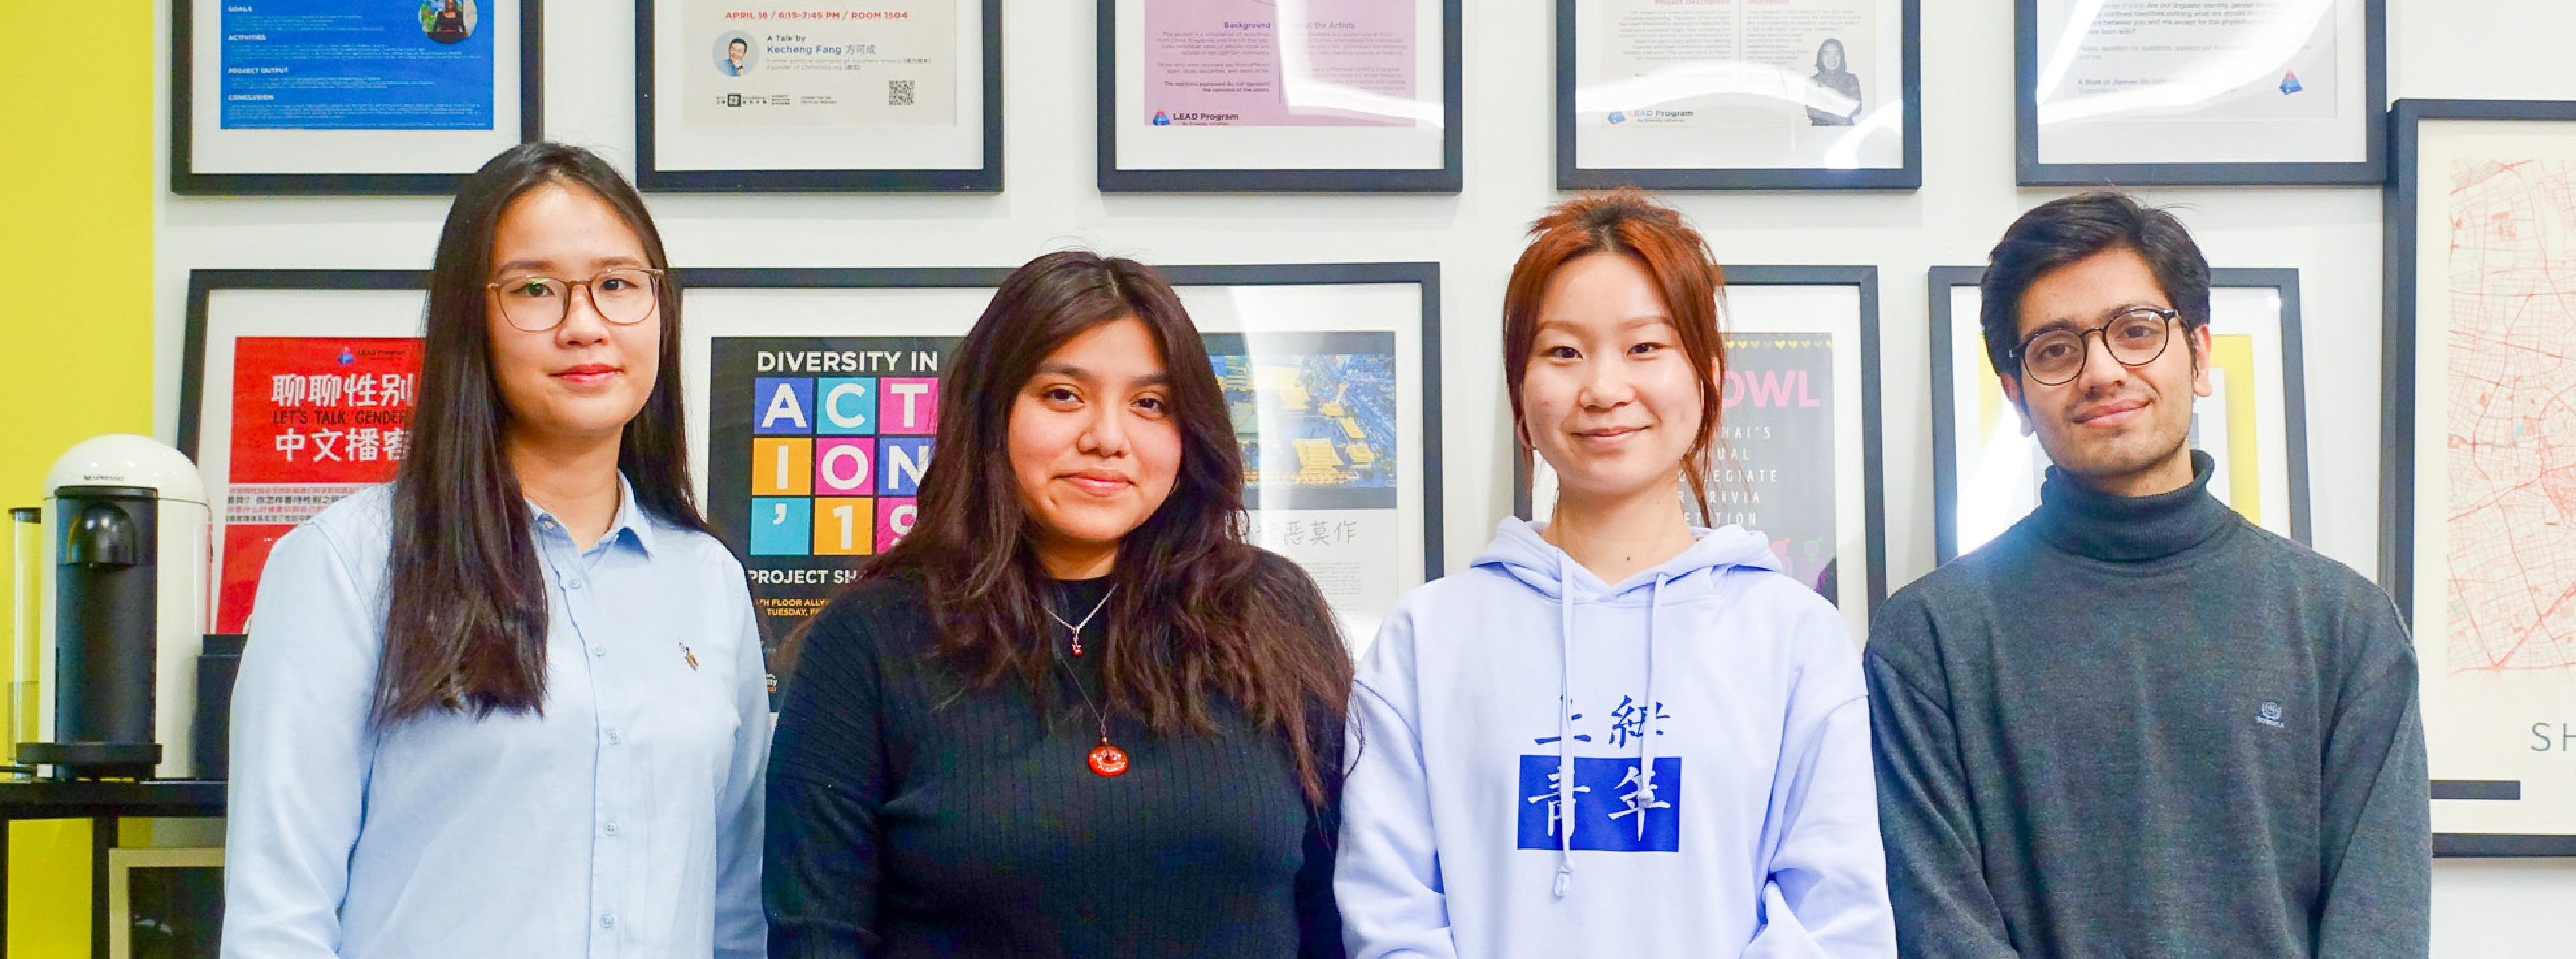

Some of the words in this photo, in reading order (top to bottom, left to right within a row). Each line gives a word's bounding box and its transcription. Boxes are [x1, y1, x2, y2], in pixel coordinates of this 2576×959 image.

[725, 11, 755, 20] APRIL
[758, 11, 767, 20] 16
[778, 11, 823, 20] 6:15-7:45
[826, 11, 840, 20] PM
[851, 11, 881, 20] ROOM
[885, 11, 908, 20] 1504
[767, 45, 813, 55] Kecheng
[816, 45, 842, 55] Fang
[1201, 112, 1239, 121] Program
[757, 351, 901, 372] DIVERSITY
[911, 351, 938, 372] IN
[271, 373, 414, 407] 聊聊性别
[273, 408, 307, 424] LET'S
[314, 410, 345, 424] TALK
[1722, 426, 1771, 439] HAI'S
[276, 428, 411, 462] 中文播客
[1717, 448, 1749, 460] UAL
[1710, 491, 1760, 504] RIVIA
[1684, 512, 1757, 526] ETTION
[1255, 520, 1358, 545] 恶莫作
[748, 570, 829, 584] PROJECT
[766, 608, 808, 617] TUESDAY,
